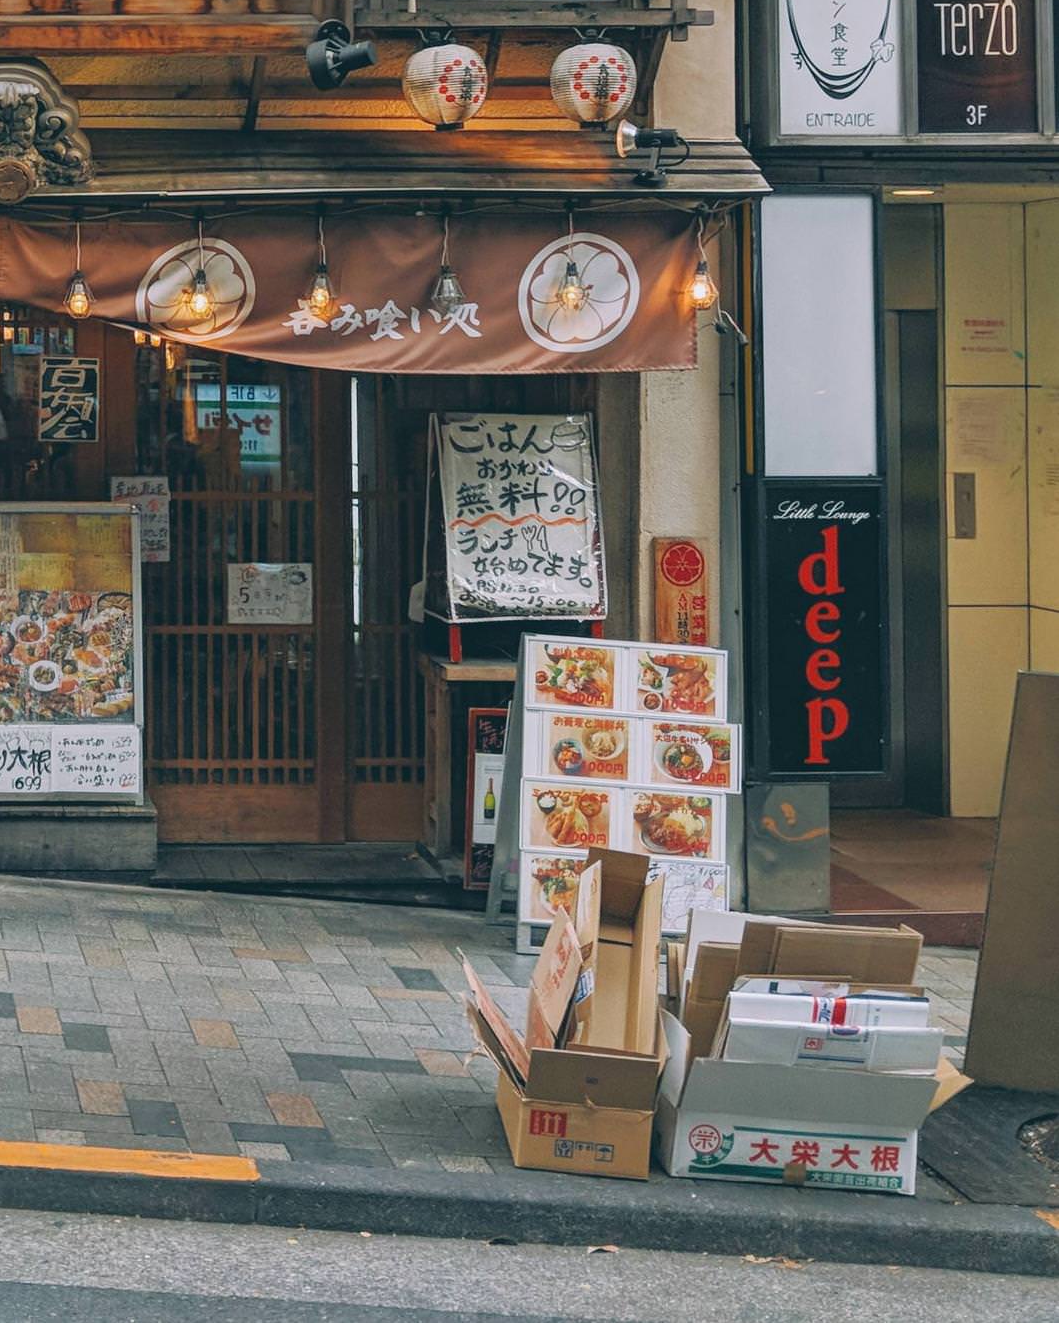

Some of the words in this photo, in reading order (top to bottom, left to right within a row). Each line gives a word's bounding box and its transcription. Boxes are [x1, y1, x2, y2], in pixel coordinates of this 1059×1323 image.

[806, 112, 875, 127] ENTRAIDE
[966, 105, 988, 125] 3F
[281, 299, 482, 341] 呑み喰い処
[449, 421, 554, 453] ごはん
[773, 500, 816, 521] Little
[818, 500, 870, 525] Lounge
[457, 529, 519, 555] ランチ
[798, 525, 851, 765] deep
[748, 1138, 900, 1172] 大栄大根
